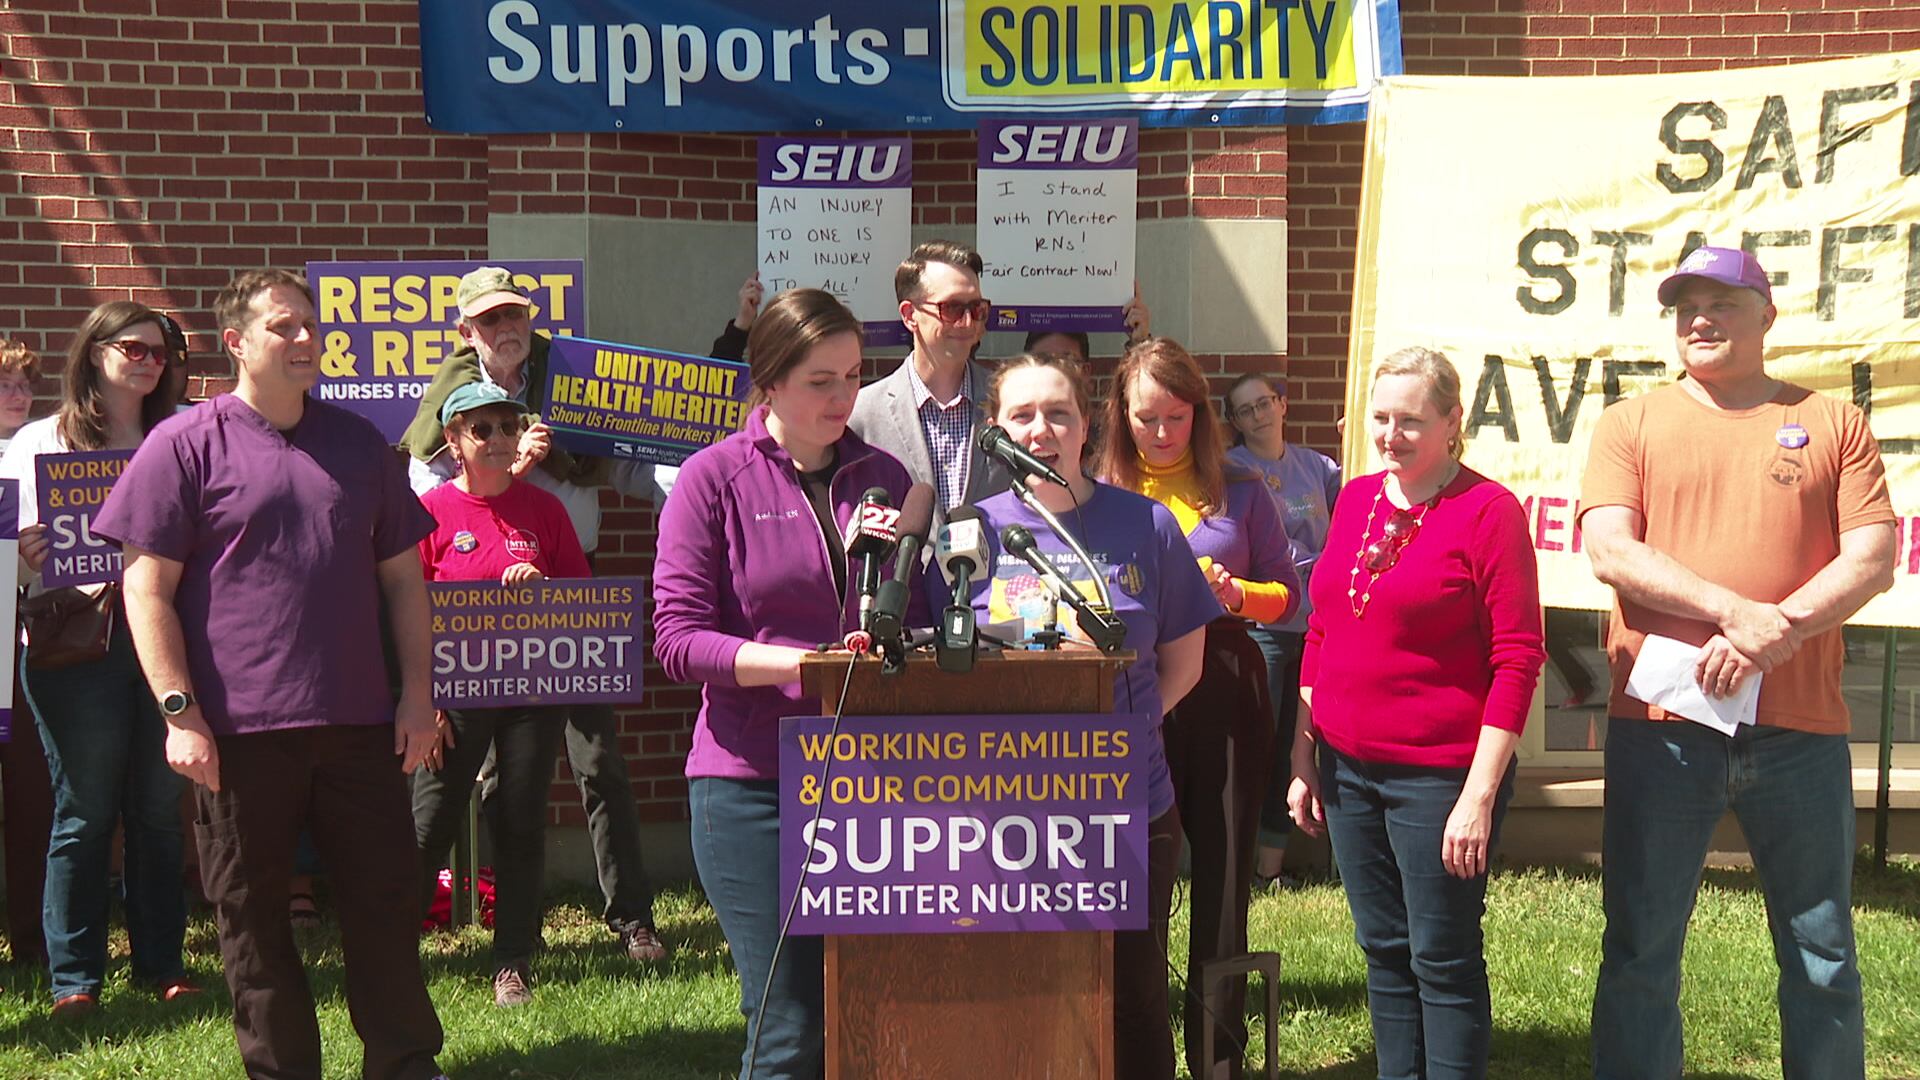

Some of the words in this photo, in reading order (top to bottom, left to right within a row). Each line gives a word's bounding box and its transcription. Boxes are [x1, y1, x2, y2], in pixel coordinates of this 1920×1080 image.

[487, 0, 890, 107] Supports
[980, 0, 1335, 88] SOLIDARITY
[993, 125, 1128, 164] SEIU
[771, 144, 901, 182] SEIU
[998, 181, 1014, 197] I
[1042, 181, 1107, 197] stand
[769, 196, 797, 214] AN
[821, 196, 884, 217] INJURY
[994, 210, 1031, 226] with
[1046, 210, 1118, 227] Meriter
[765, 228, 793, 242] TO
[807, 228, 841, 243] ONE
[857, 228, 873, 242] IS
[765, 251, 790, 265] AN
[814, 251, 872, 266] INJURY
[1020, 263, 1079, 277] Contract
[1085, 261, 1119, 277] Now!
[770, 278, 798, 292] TO
[821, 276, 859, 294] ALL!
[319, 274, 573, 324] RESPT
[320, 331, 359, 378] &
[594, 349, 738, 398] UNITYPOINT
[320, 383, 394, 401] NURSES
[549, 405, 584, 425] Show
[586, 411, 603, 428] Us
[603, 415, 664, 437] Frontline
[661, 422, 712, 444] Workers
[49, 488, 65, 508] &
[861, 506, 901, 530] 27
[863, 527, 896, 542] WKOW
[432, 588, 534, 608] WORKING
[542, 587, 633, 605] FAMILIES
[431, 617, 446, 633] &
[451, 615, 496, 632] OUR
[501, 612, 633, 631] COMMUNITY
[433, 635, 633, 675] SUPPORT
[433, 678, 530, 699] MERITER
[537, 674, 632, 694] NURSES!
[798, 731, 967, 762] WORKING
[979, 730, 1131, 760] FAMILIES
[798, 774, 822, 806] &
[830, 775, 904, 804] OUR
[913, 772, 1131, 803] COMMUNITY
[801, 814, 1131, 875] SUPPORT
[801, 884, 960, 917] MERITER
[972, 880, 1128, 913] NURSES!
